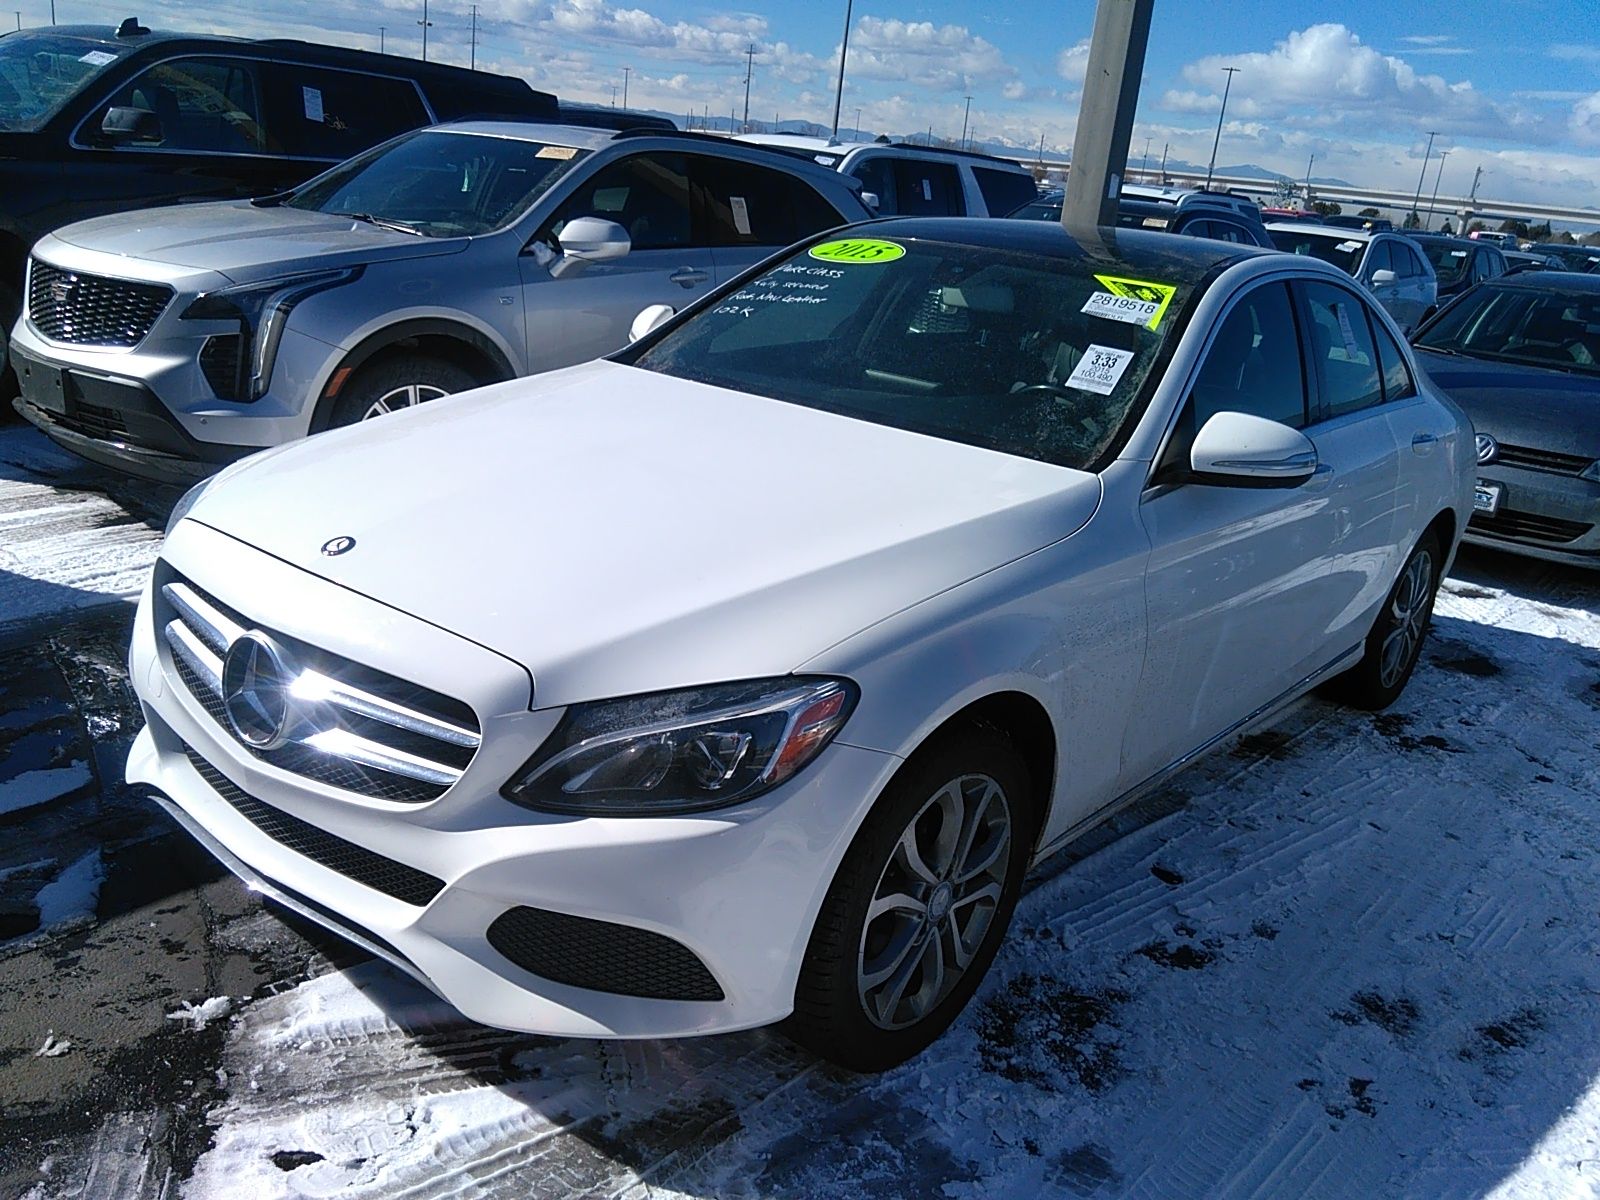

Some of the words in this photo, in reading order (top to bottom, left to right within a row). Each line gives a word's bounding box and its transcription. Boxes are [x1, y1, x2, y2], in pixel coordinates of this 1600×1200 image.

[818, 243, 895, 259] 2015
[1092, 294, 1156, 315] 2819518
[1091, 354, 1118, 369] 3:33
[1090, 365, 1110, 375] 2015
